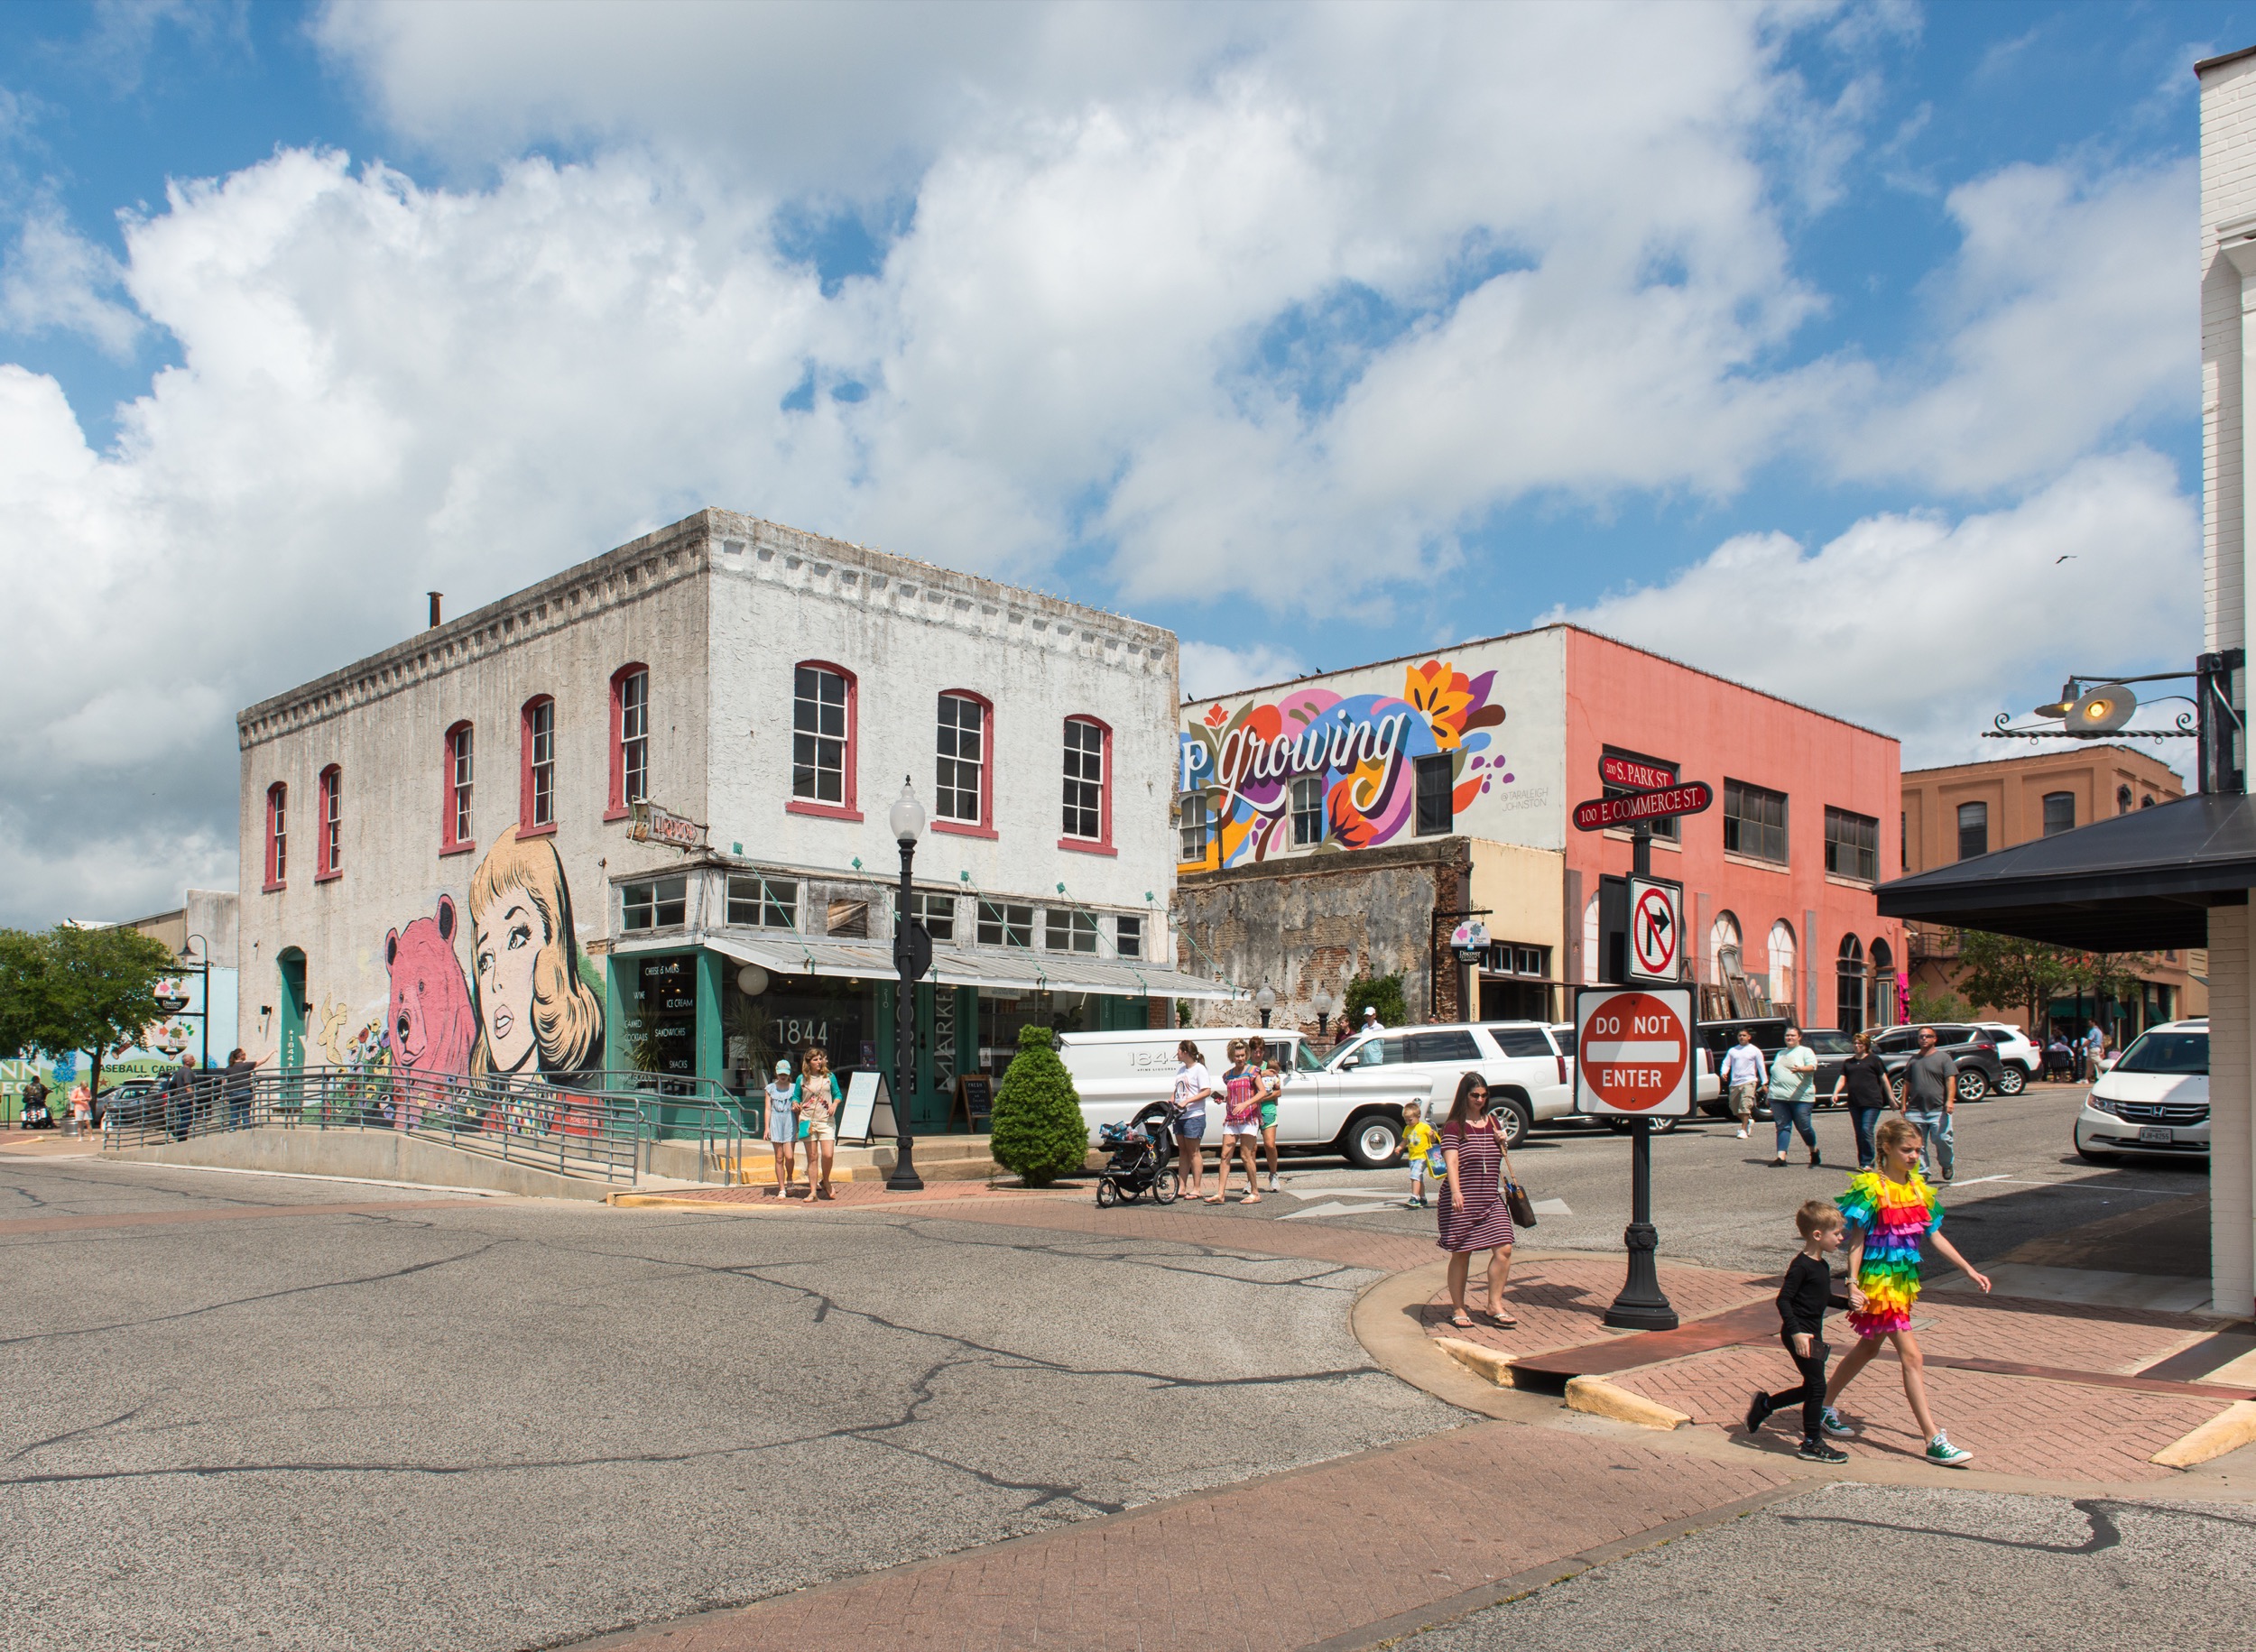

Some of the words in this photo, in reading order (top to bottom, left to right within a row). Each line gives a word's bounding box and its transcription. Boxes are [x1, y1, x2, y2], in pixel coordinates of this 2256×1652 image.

[1606, 763, 1616, 774] 200
[1616, 761, 1626, 780] S.
[1627, 764, 1655, 788] PARK
[1502, 798, 1547, 812] JOHNSTON
[1581, 808, 1597, 823] 100
[1602, 803, 1611, 821] E.
[1613, 790, 1681, 819] COMMERCE
[1683, 788, 1701, 808] ST.
[645, 967, 659, 975] CHEESE
[633, 992, 645, 1000] WINE
[674, 999, 693, 1008] CREAM
[654, 1028, 686, 1037] SANDWICHES
[776, 1019, 828, 1046] 1844
[1595, 1017, 1620, 1035] DO
[1634, 1016, 1671, 1034] NOT
[936, 983, 954, 1091] MARKET
[1603, 1069, 1661, 1087] ENTER
